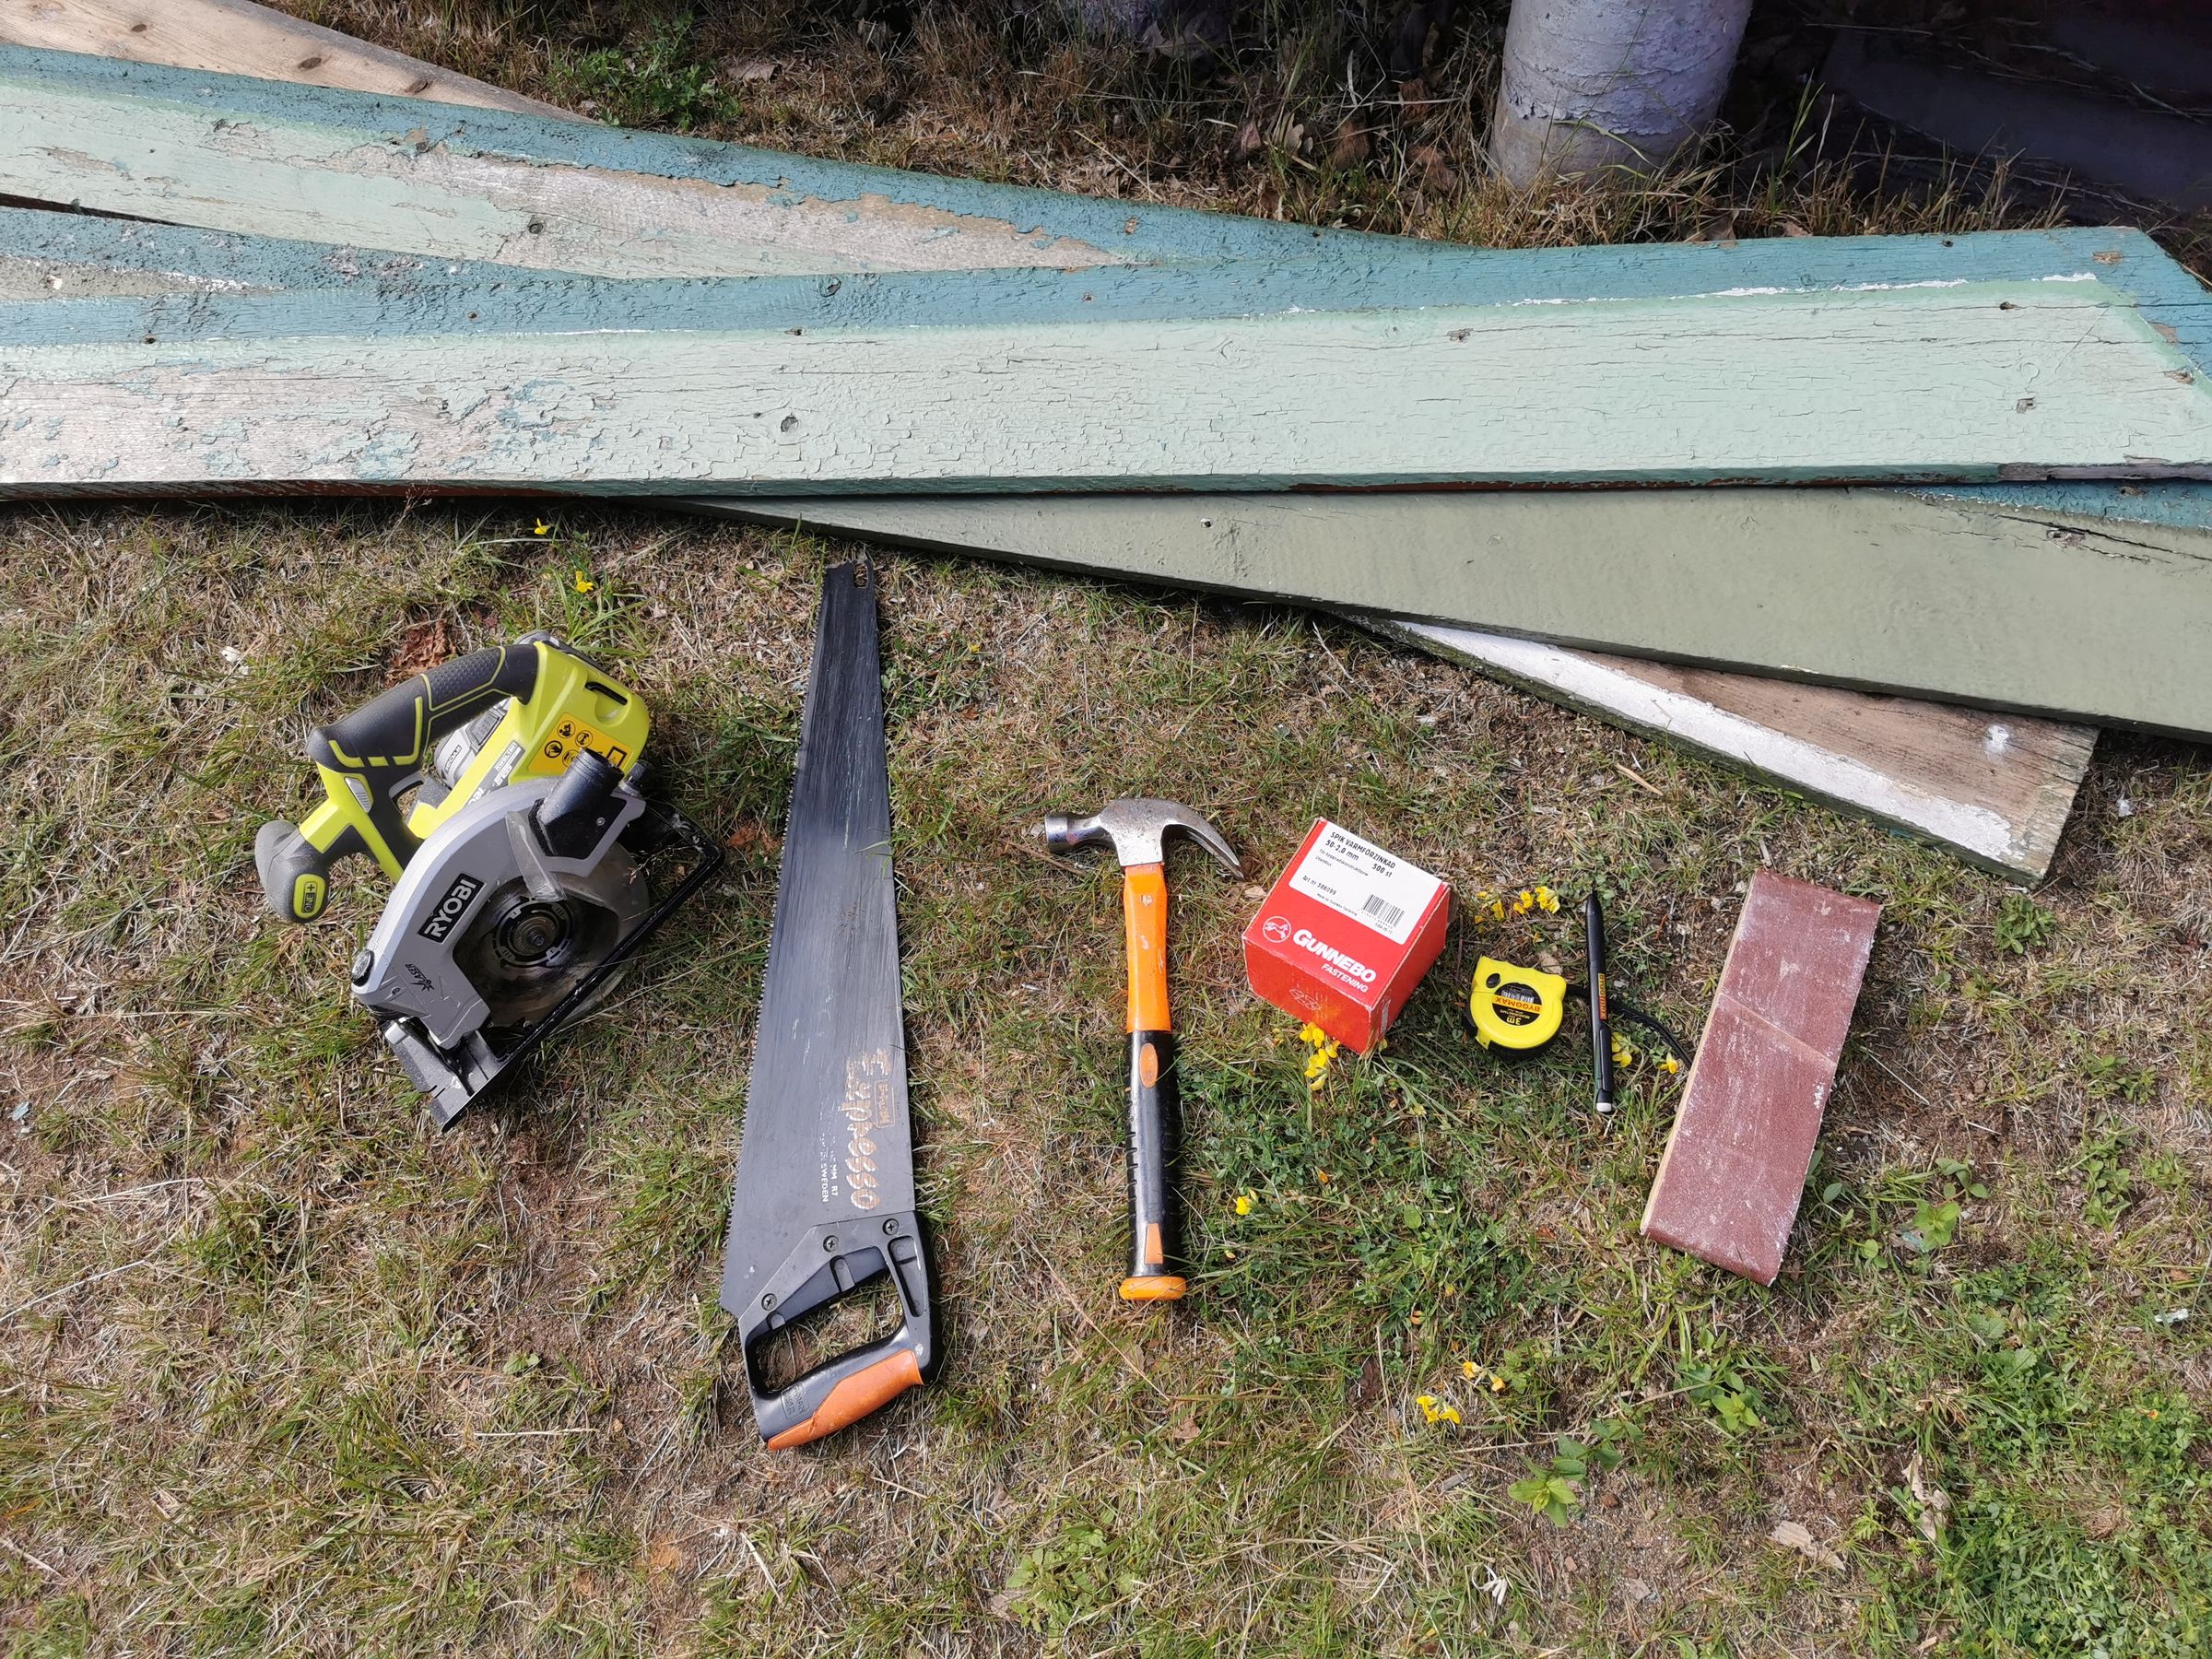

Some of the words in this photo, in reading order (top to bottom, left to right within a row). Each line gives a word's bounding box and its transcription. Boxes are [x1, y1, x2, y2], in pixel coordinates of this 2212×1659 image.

[1330, 831, 1346, 842] SPIK
[1346, 839, 1396, 869] VARMFÖRZINKAD
[1346, 851, 1359, 861] mm
[1372, 864, 1386, 874] 500
[424, 879, 477, 937] RYOBI
[1293, 929, 1376, 982] GUNNEBO
[406, 964, 427, 984] LASER
[1321, 963, 1369, 993] FASTENING
[1496, 996, 1540, 1012] BYGGMAX
[820, 1163, 829, 1203] SWEDEN
